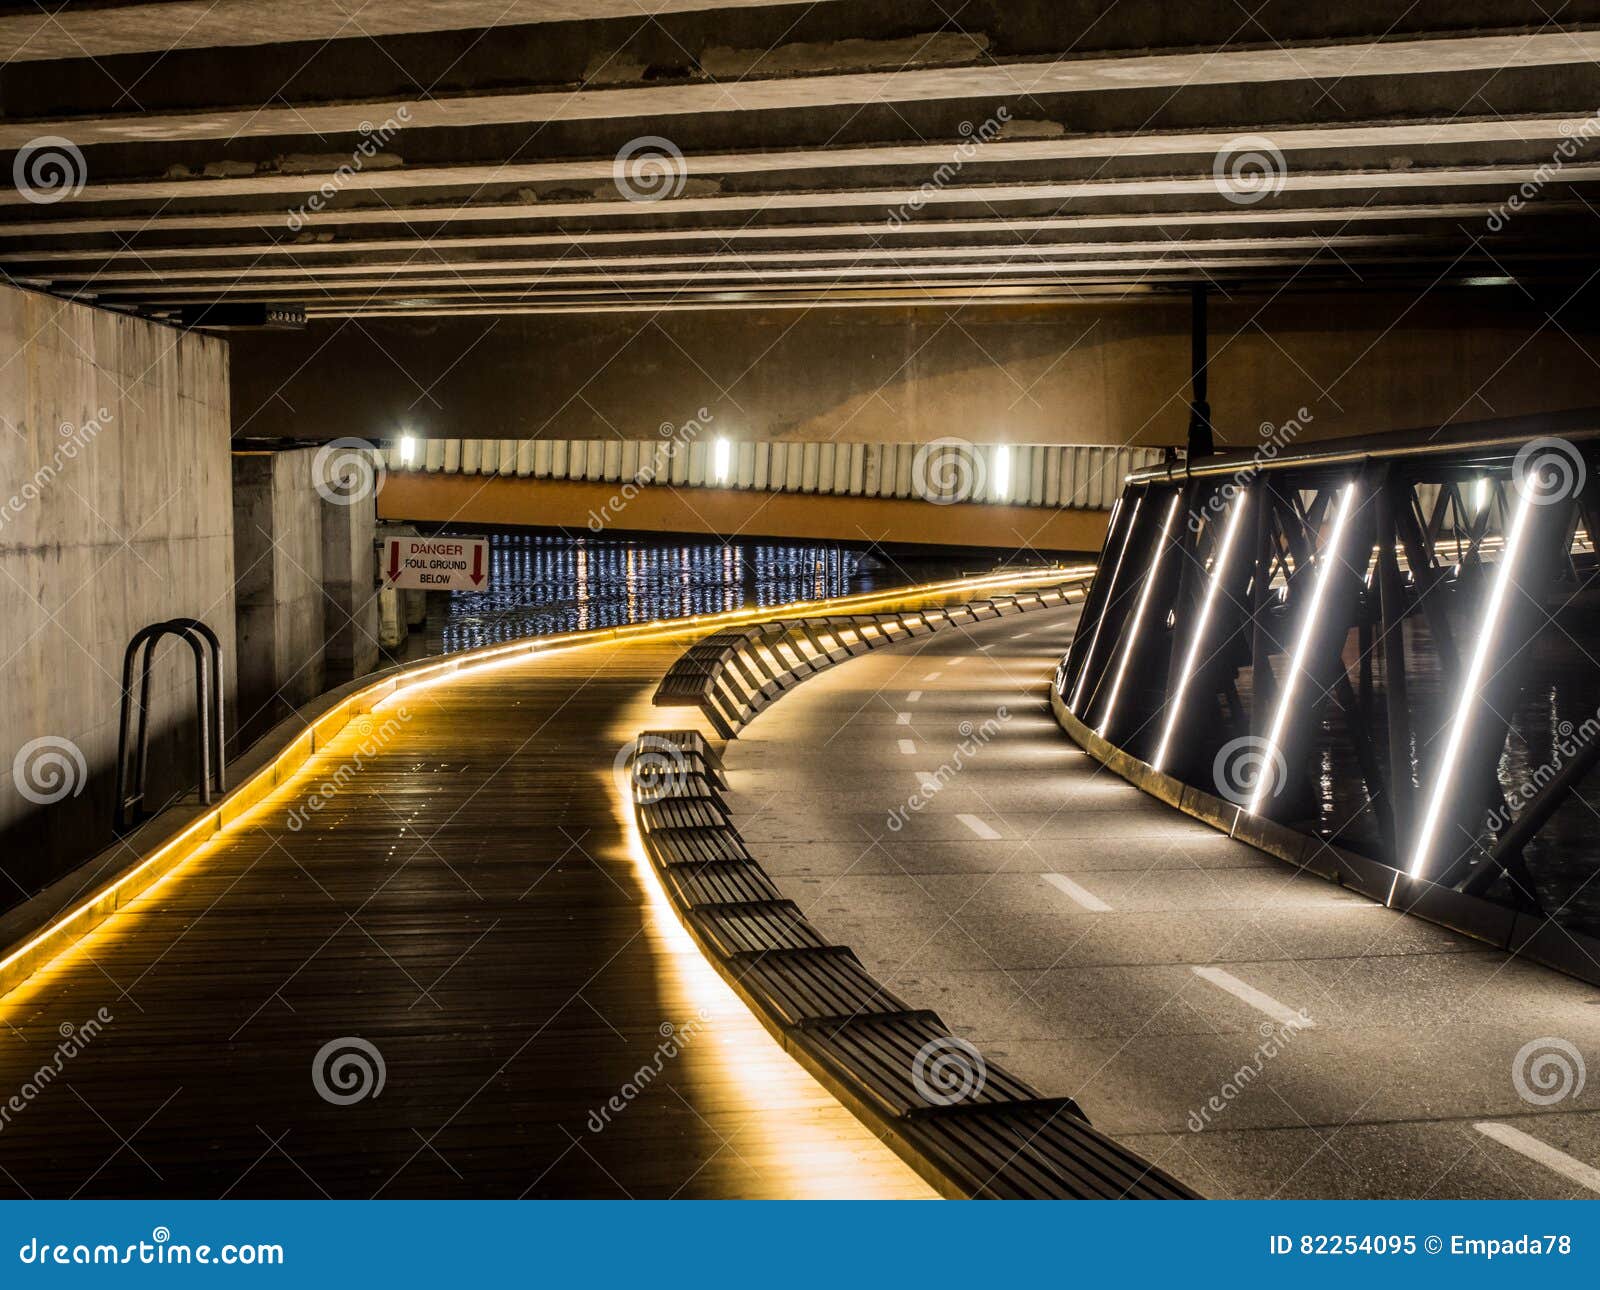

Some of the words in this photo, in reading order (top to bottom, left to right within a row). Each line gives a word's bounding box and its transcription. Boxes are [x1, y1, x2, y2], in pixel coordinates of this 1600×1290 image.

[410, 543, 463, 555] DANGER
[405, 559, 427, 568] FOUL
[429, 560, 467, 570] GROUND
[420, 574, 451, 584] BELOW
